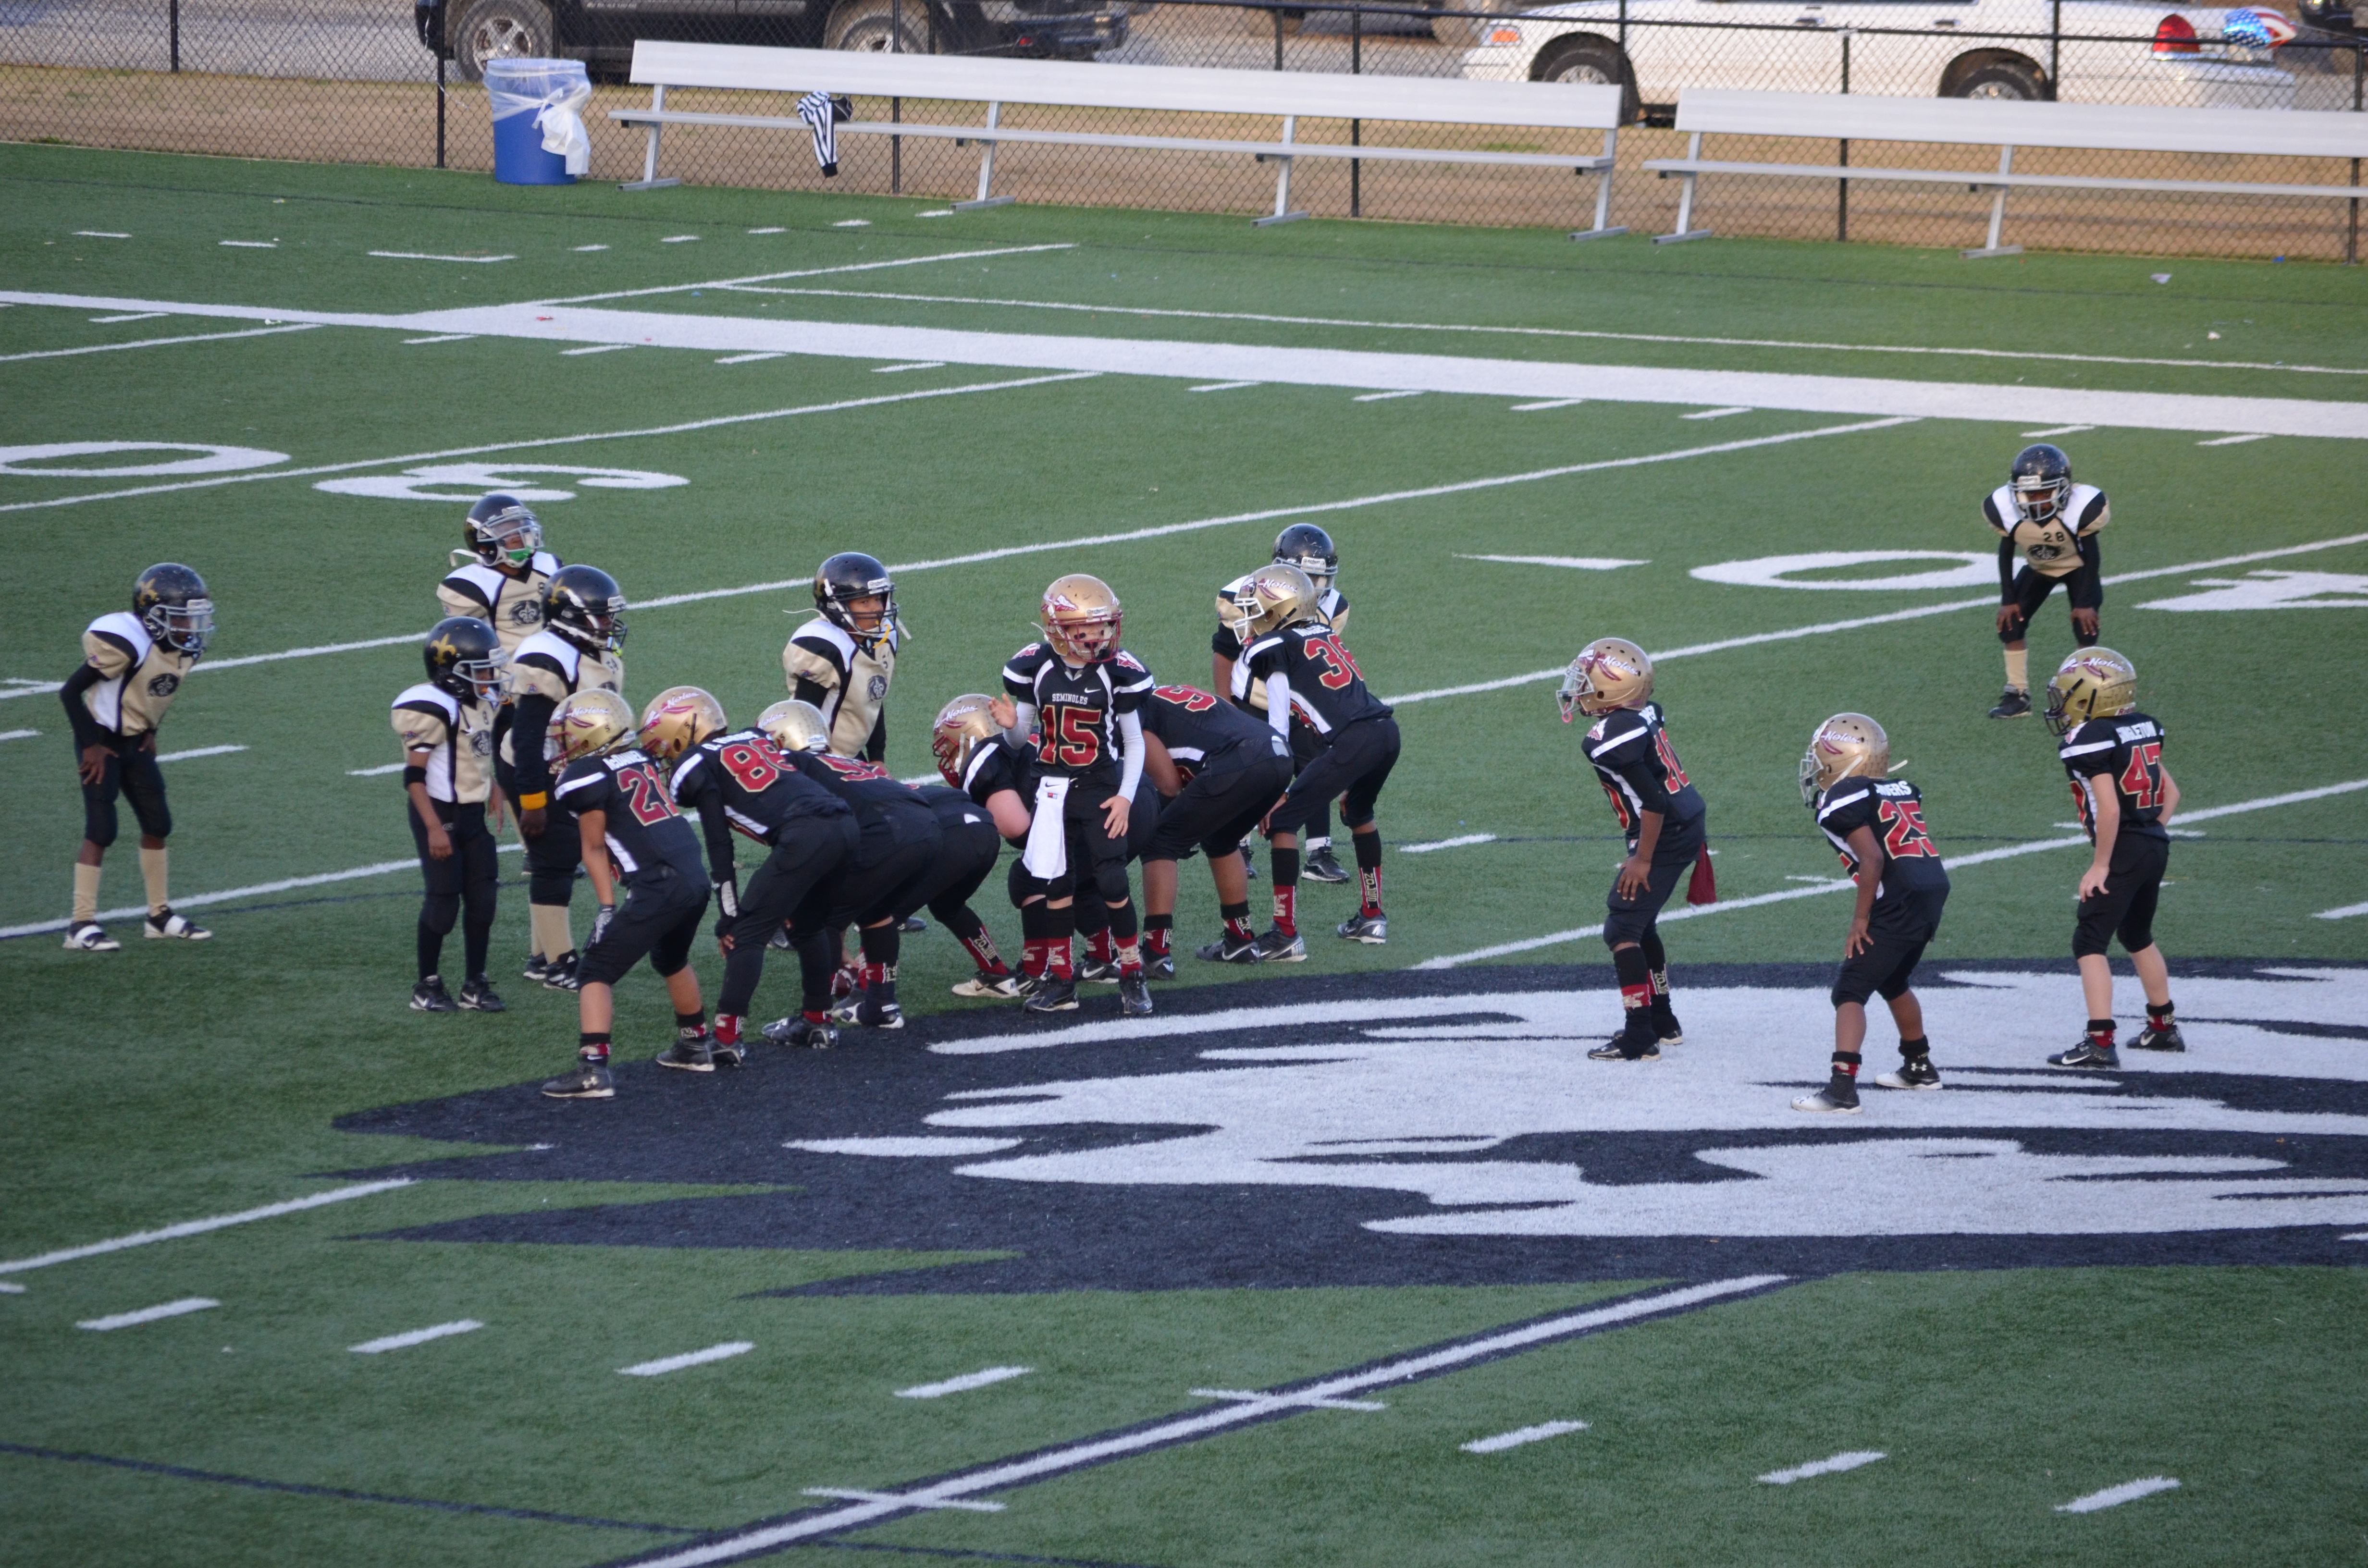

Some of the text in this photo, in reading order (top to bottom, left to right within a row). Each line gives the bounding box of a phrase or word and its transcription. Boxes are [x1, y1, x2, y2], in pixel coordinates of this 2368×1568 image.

[2043, 531, 2065, 542] 28
[1602, 655, 1639, 675] Noles
[1052, 693, 1088, 705] SEMINOLES
[571, 707, 609, 717] Noles
[945, 705, 978, 722] Noles
[1039, 704, 1102, 766] 15
[1825, 731, 1861, 744] Noles
[2119, 741, 2165, 809] 47
[617, 763, 678, 827] 21
[1877, 799, 1939, 860] 25
